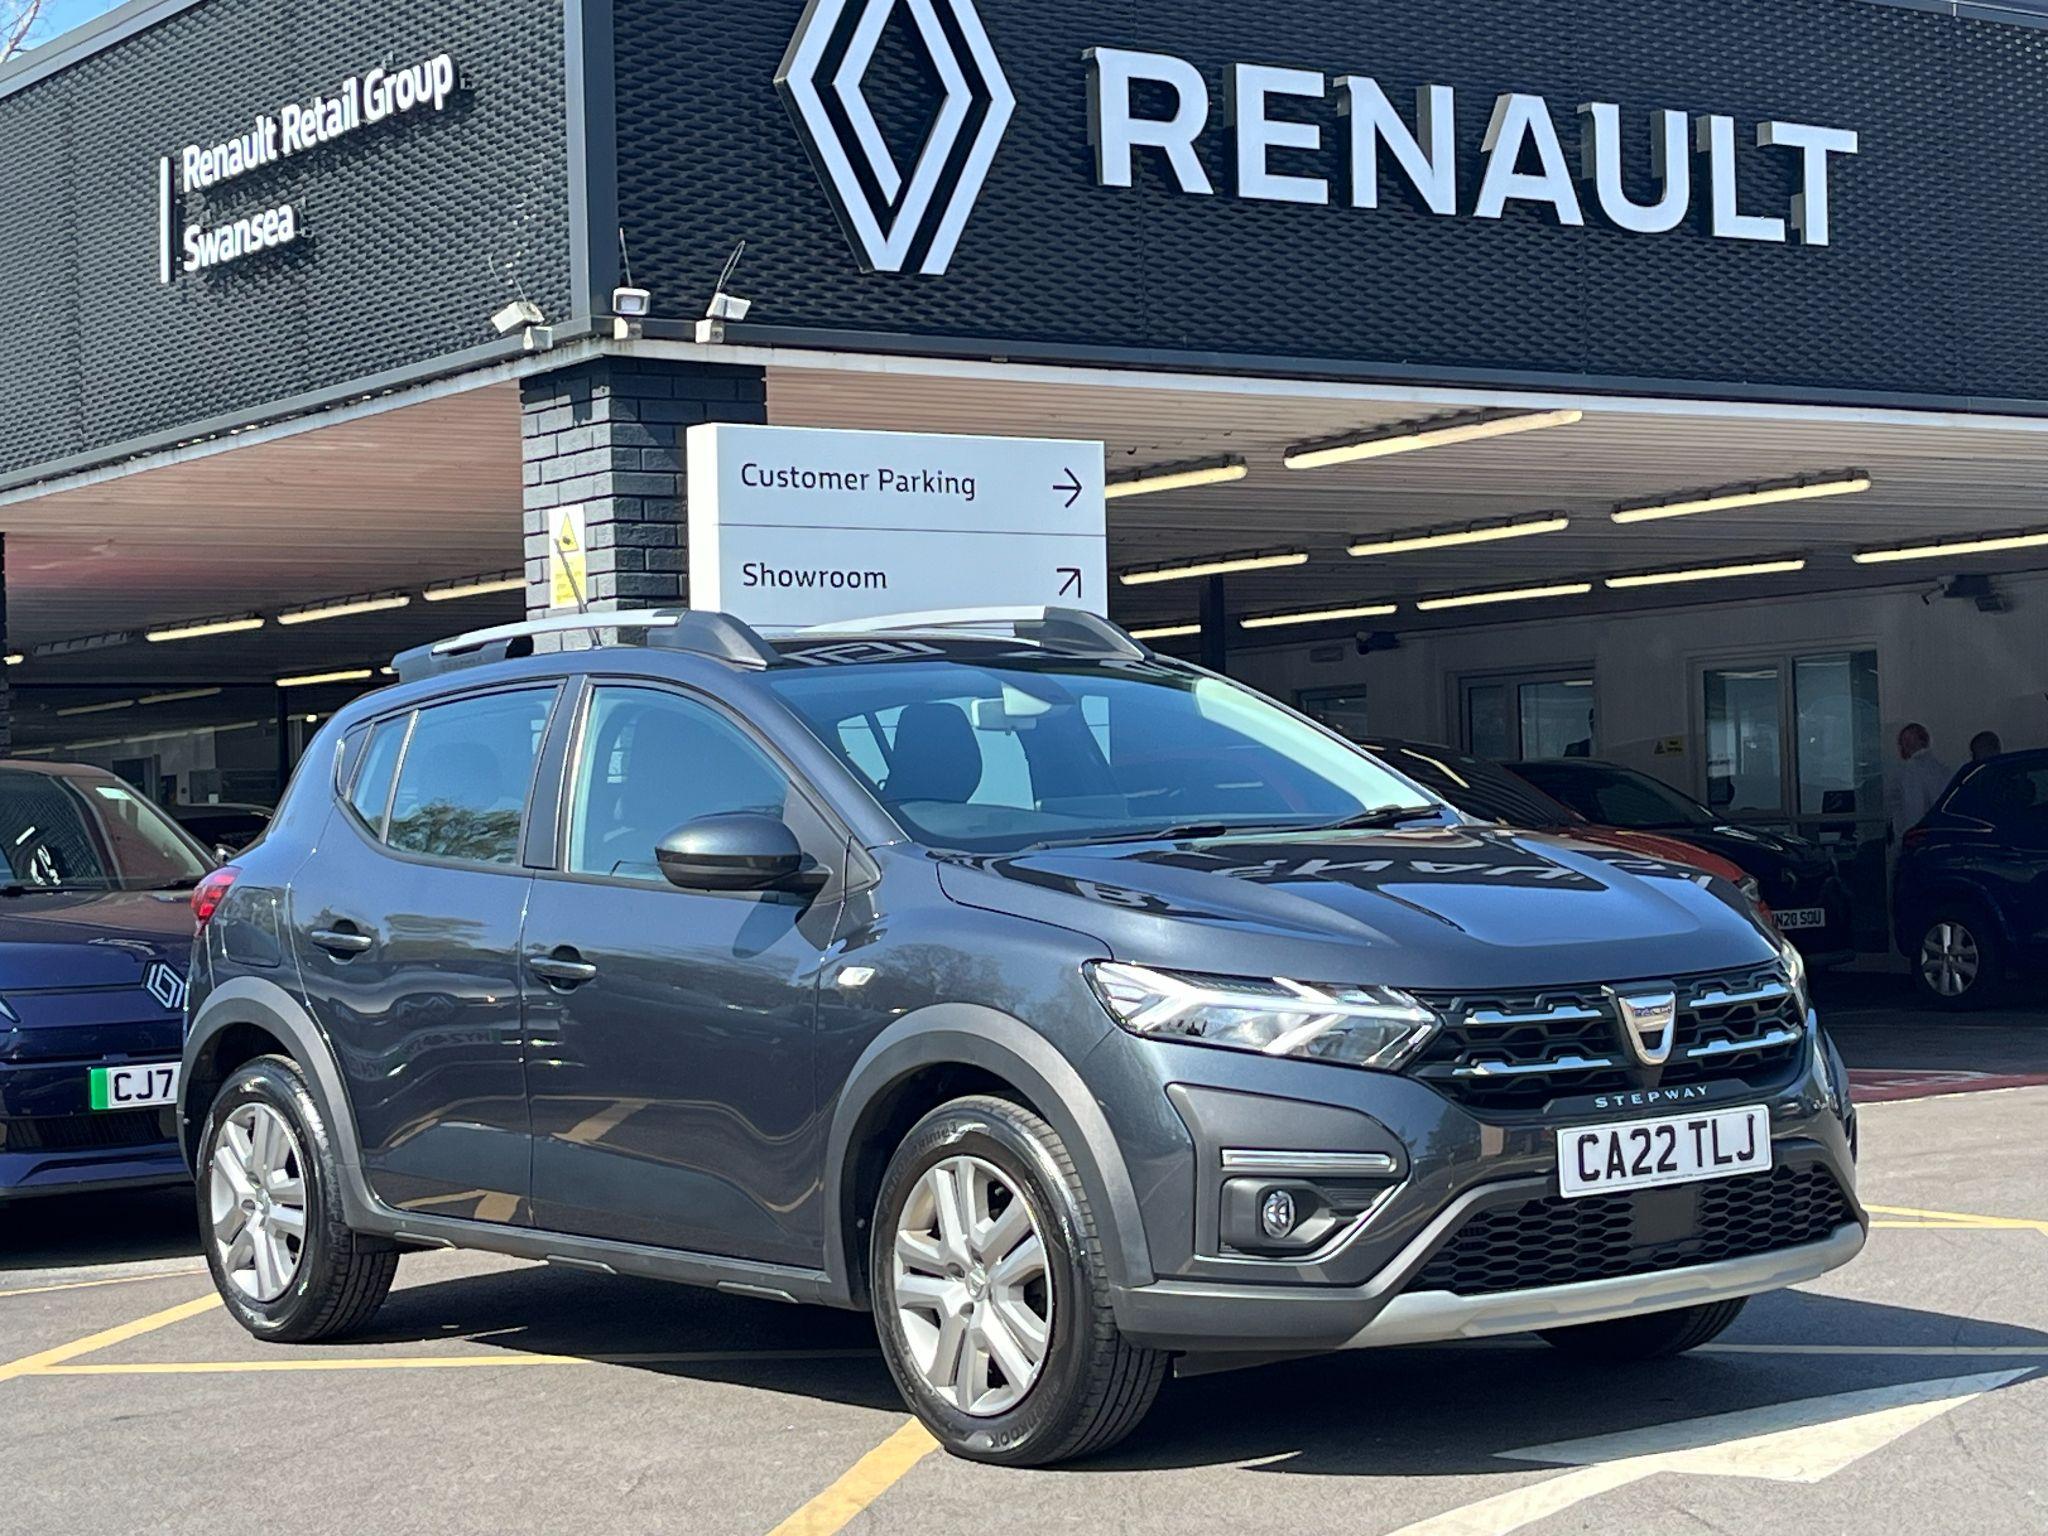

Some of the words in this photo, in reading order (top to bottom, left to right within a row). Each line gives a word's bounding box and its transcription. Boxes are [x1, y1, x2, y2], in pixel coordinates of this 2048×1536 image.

[182, 115, 278, 192] Renault
[281, 76, 360, 154] Retail
[363, 53, 453, 122] Group
[1088, 46, 1858, 248] RENAULT
[182, 204, 295, 272] Swansea
[741, 463, 870, 491] Customer
[878, 468, 976, 502] Parking
[742, 562, 888, 590] Showroom
[1771, 911, 1798, 927] N20
[1594, 1084, 1708, 1109] STEPWAY
[1577, 1124, 1678, 1182] CA22
[1687, 1113, 1755, 1168] TLJ
